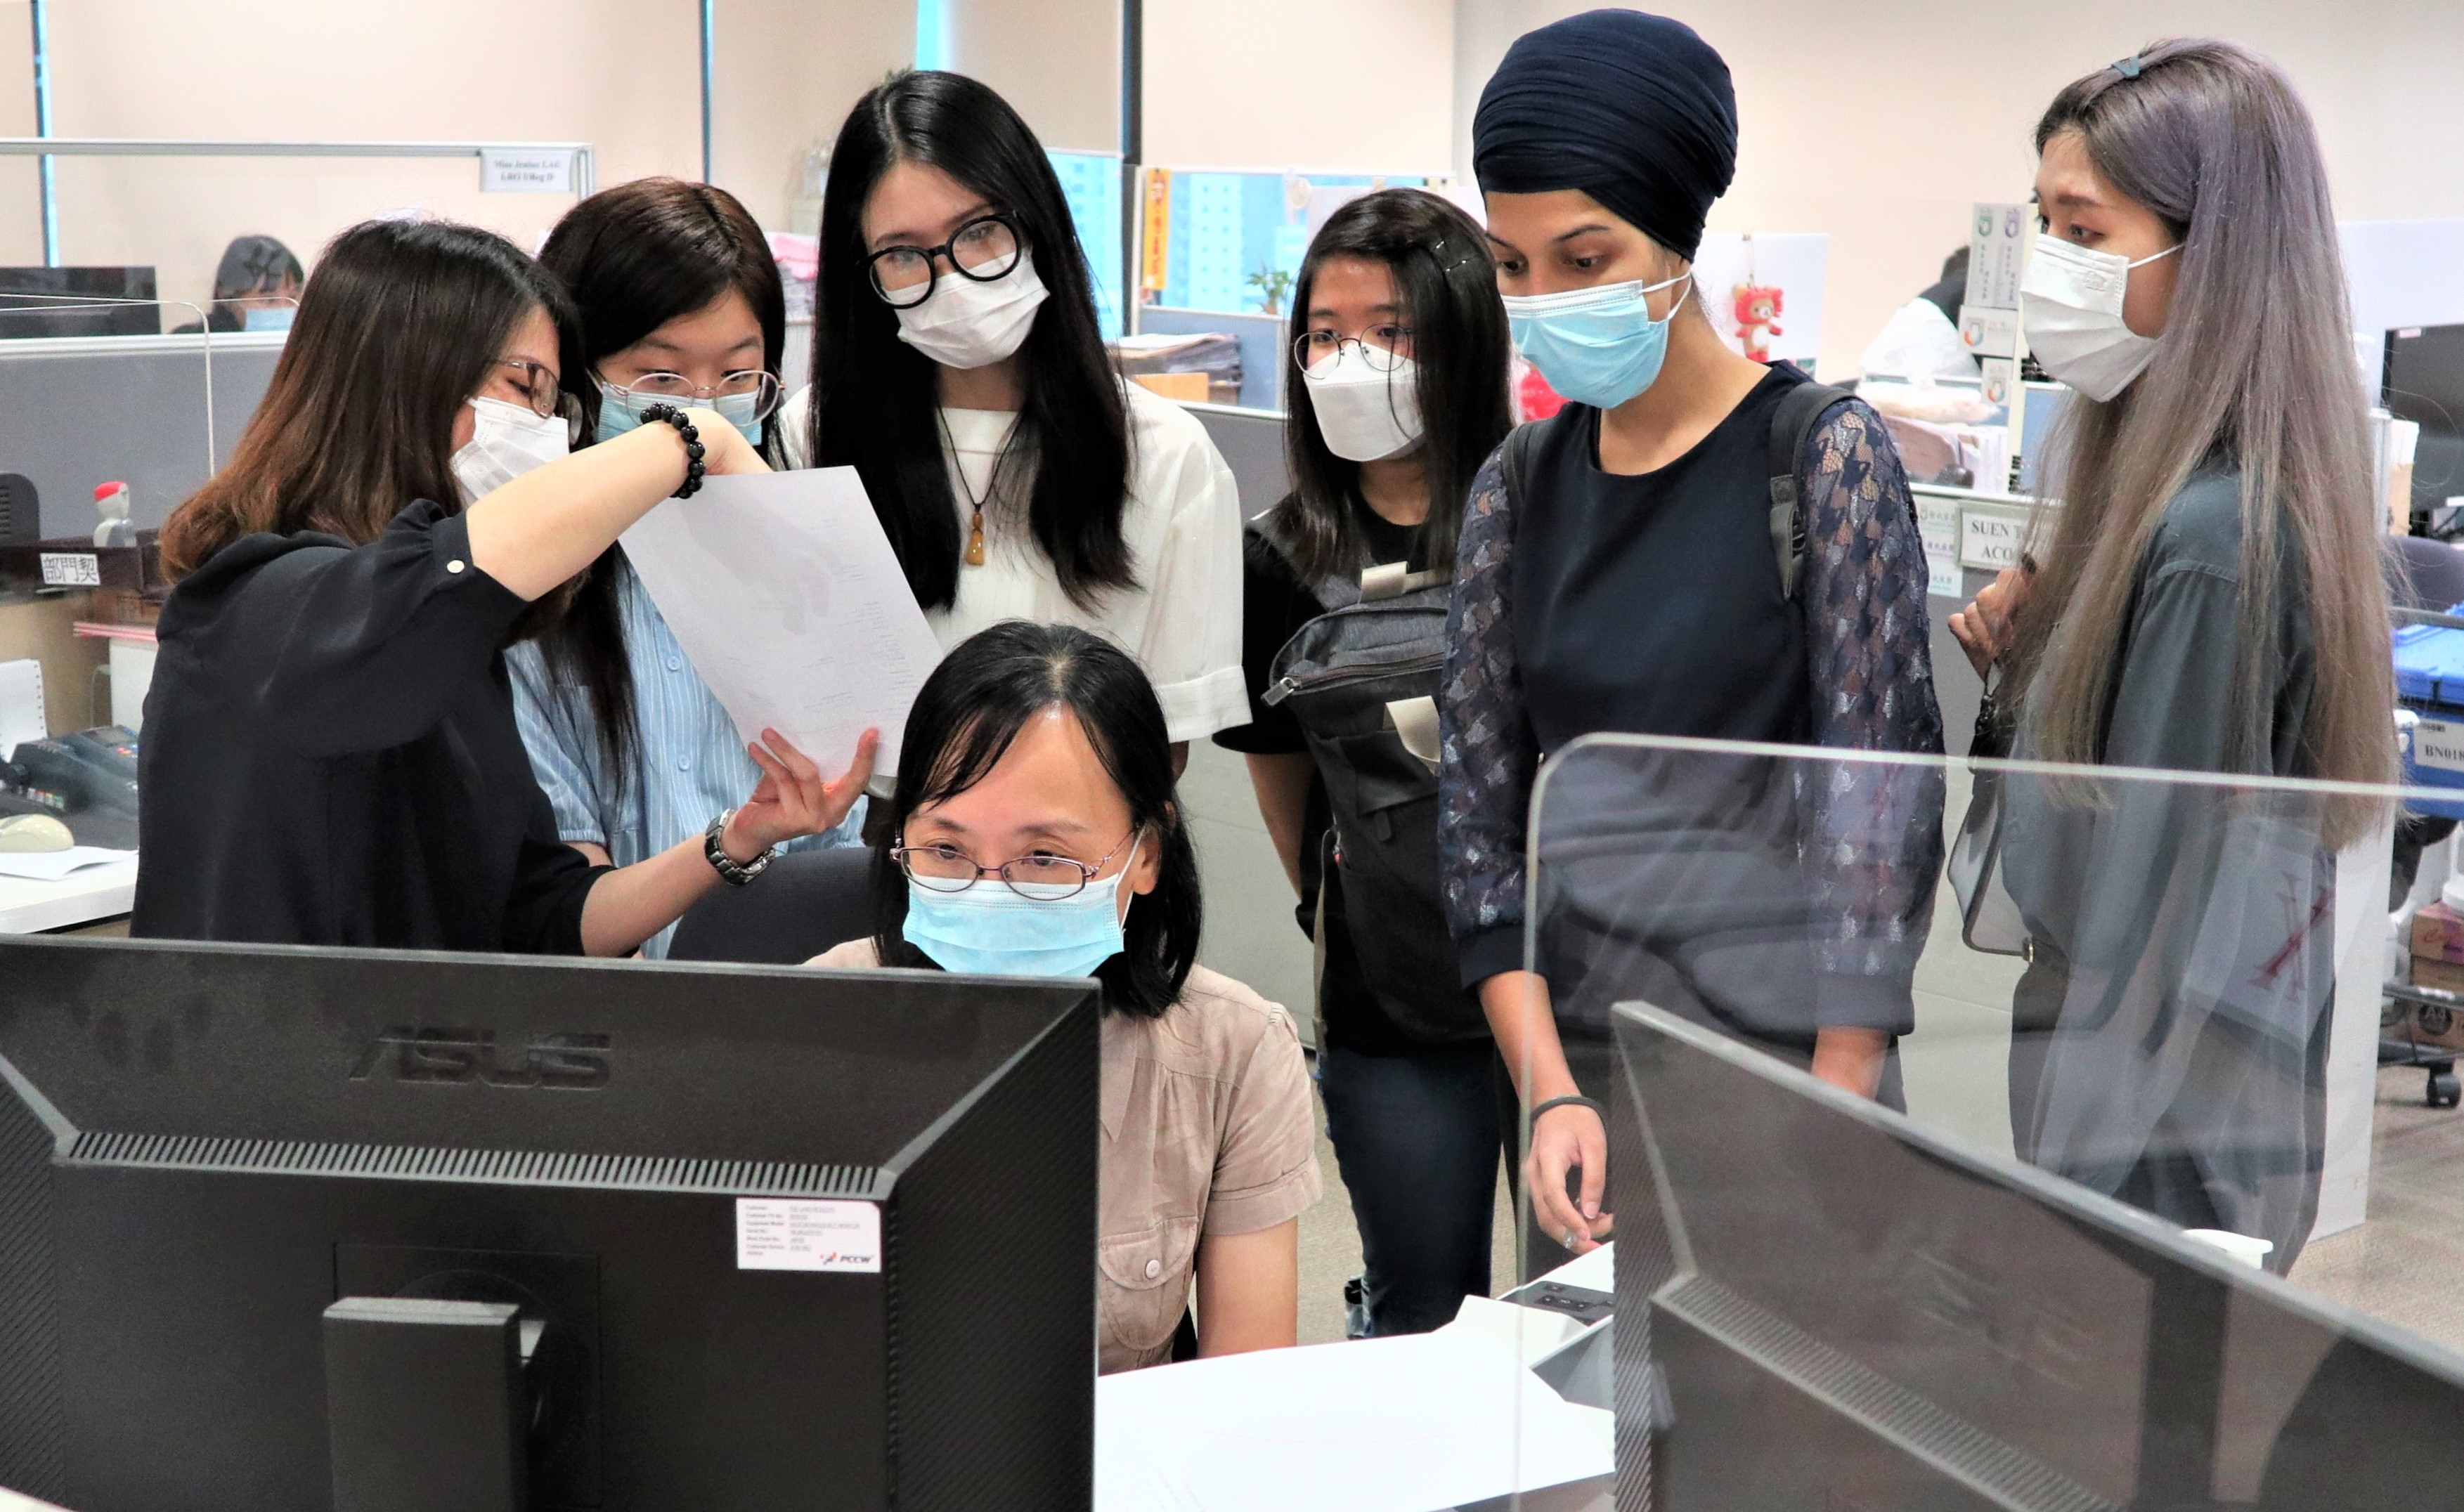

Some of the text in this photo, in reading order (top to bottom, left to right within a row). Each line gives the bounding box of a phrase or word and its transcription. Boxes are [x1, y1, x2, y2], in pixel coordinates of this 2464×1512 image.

[1971, 521, 2009, 537] SUEN
[349, 1025, 610, 1091] ASUS
[840, 1256, 871, 1264] PCCW
